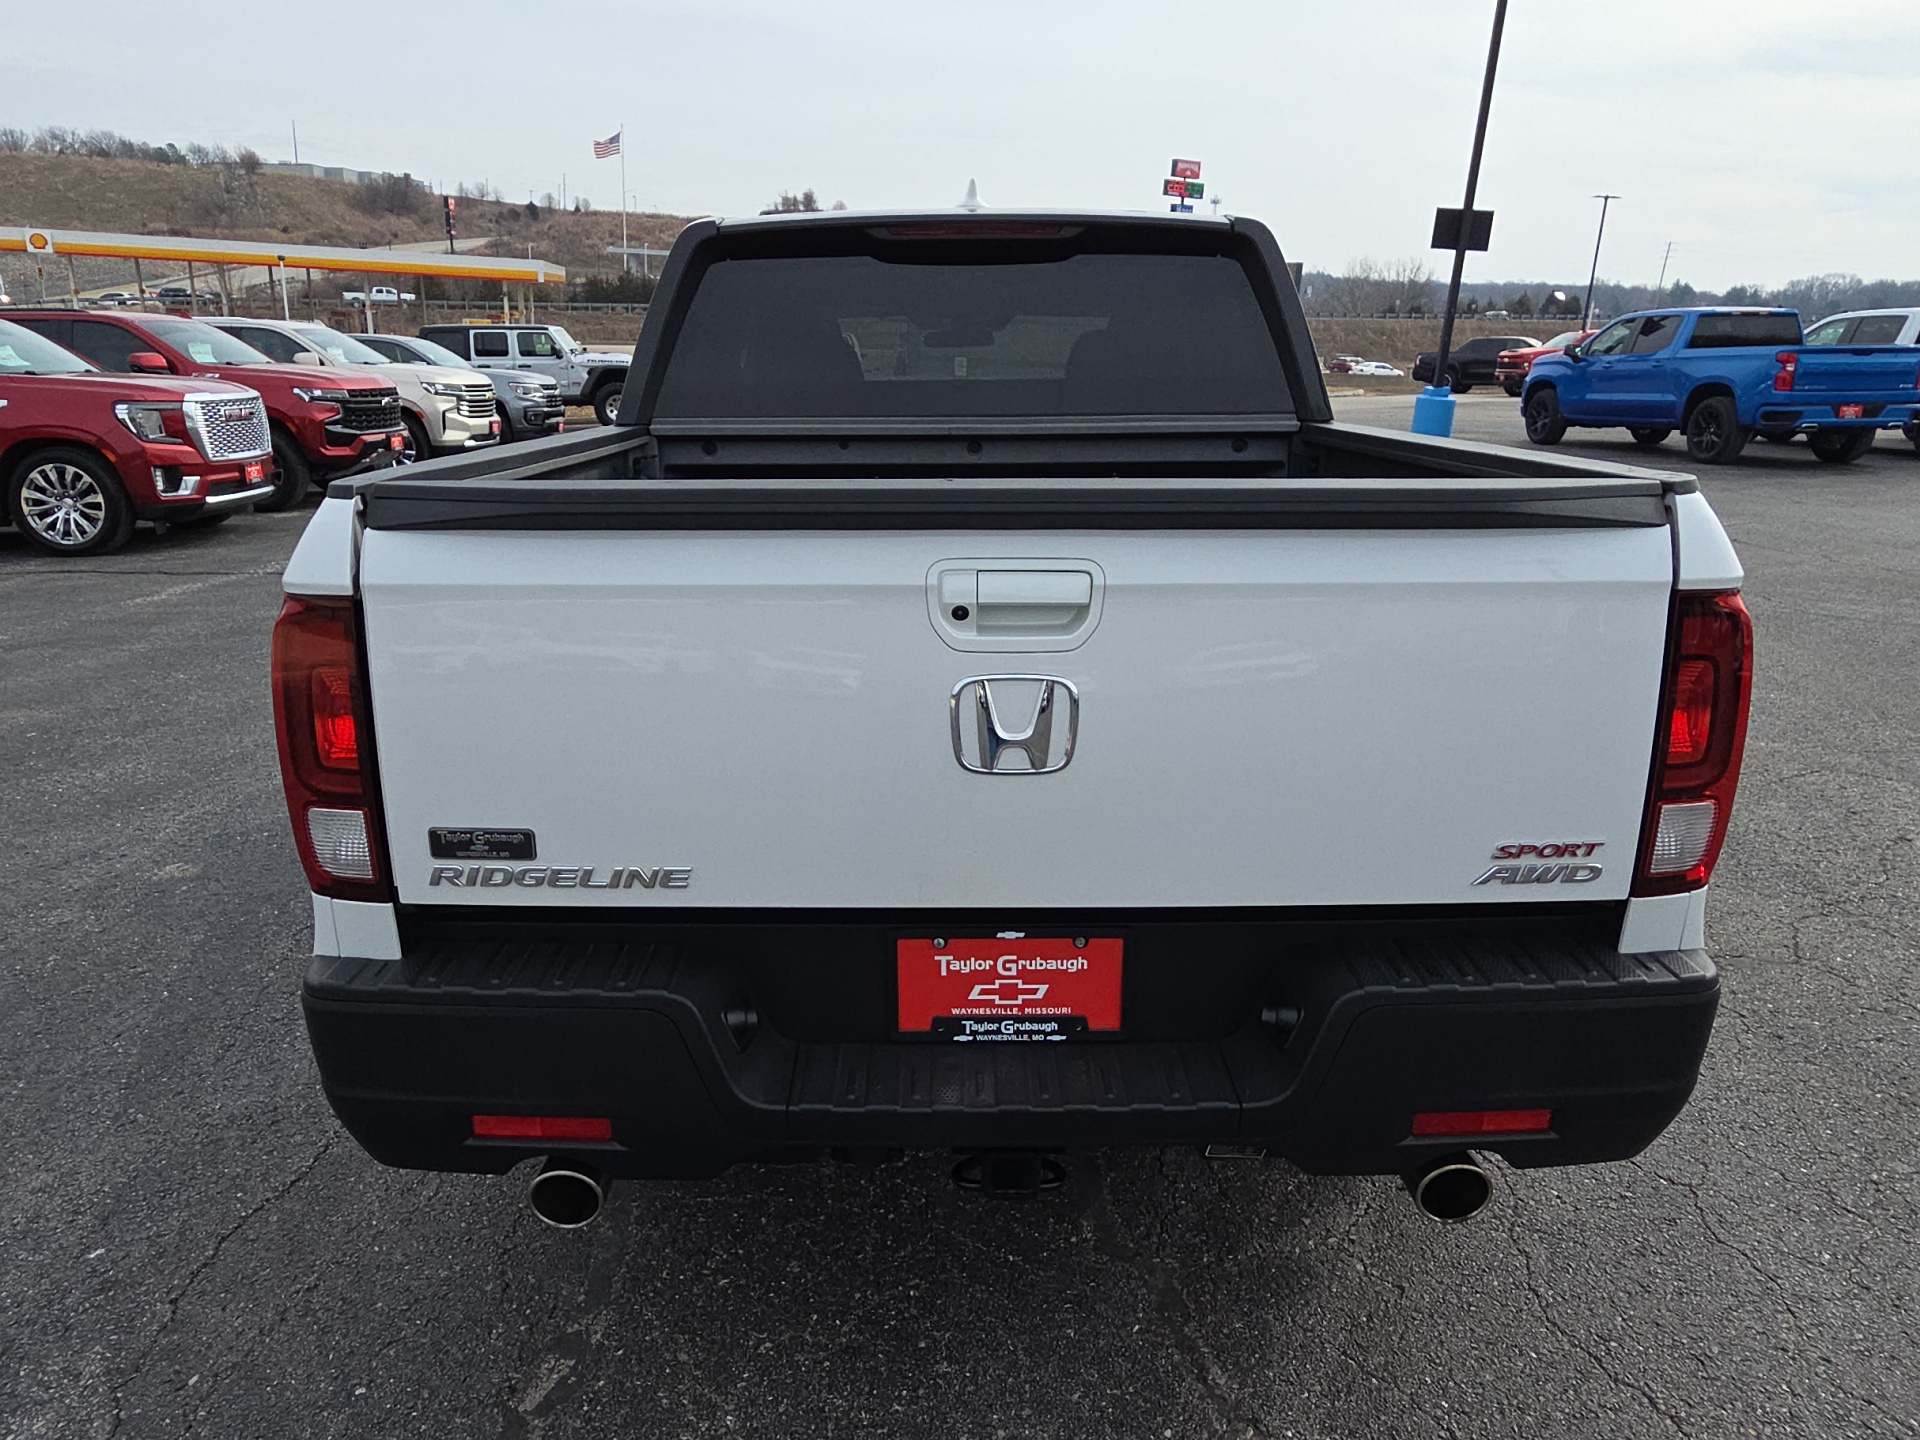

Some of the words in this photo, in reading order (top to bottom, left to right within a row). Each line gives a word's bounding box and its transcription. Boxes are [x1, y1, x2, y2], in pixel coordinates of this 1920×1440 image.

[437, 830, 471, 844] Taylor
[472, 831, 524, 844] Grubaugh
[1491, 841, 1605, 860] SPORT
[428, 864, 693, 889] RIDGELINE
[1470, 863, 1603, 886] AWD
[934, 955, 993, 976] Taylor
[996, 955, 1088, 976] Grubaugh
[951, 1007, 1021, 1016] WAYNESVILLE,
[1024, 1006, 1072, 1015] MISSOURI
[961, 1020, 1000, 1034] Taylor
[1000, 1020, 1058, 1034] Grubaugh
[975, 1034, 1031, 1042] WAYNESVILLE,
